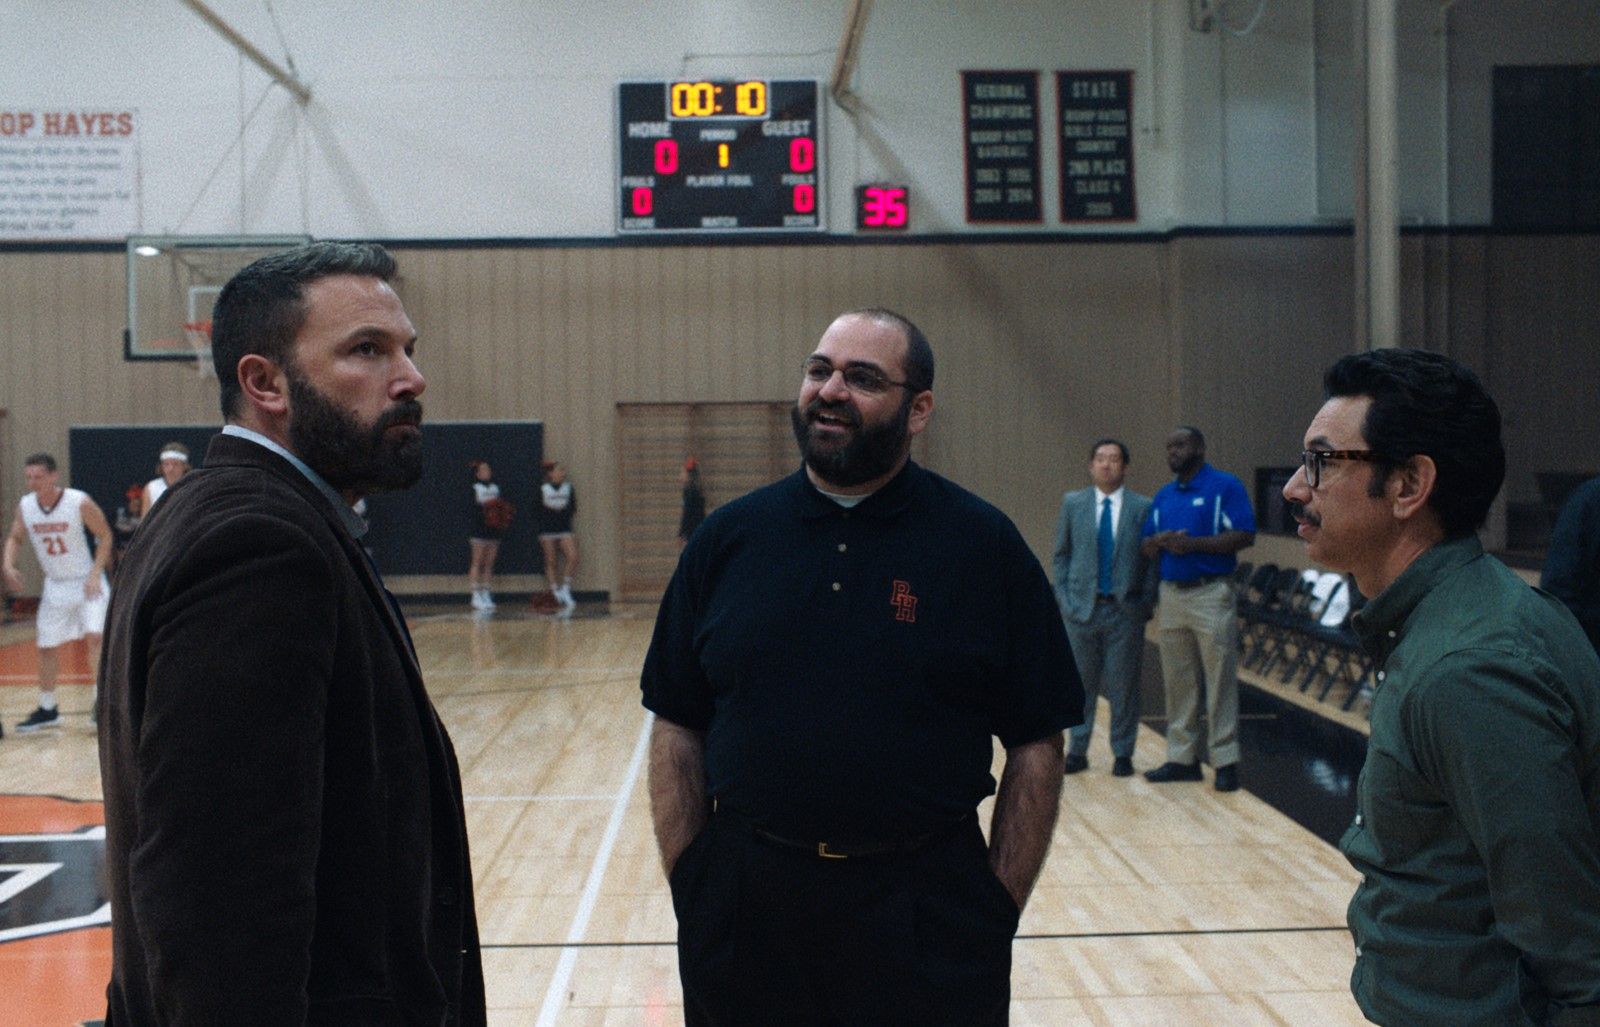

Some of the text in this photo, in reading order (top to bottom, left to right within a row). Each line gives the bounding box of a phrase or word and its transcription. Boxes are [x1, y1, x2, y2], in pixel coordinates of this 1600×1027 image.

[1072, 81, 1117, 98] STATE
[43, 112, 133, 136] HAYES
[629, 122, 672, 137] HOME
[762, 120, 810, 136] GUEST
[654, 139, 679, 175] 0
[718, 143, 730, 169] 1
[790, 137, 815, 173] 0
[1093, 160, 1126, 175] PLACE
[632, 187, 652, 216] 0
[793, 184, 814, 213] 0
[864, 187, 908, 227] 35
[42, 536, 69, 556] 21
